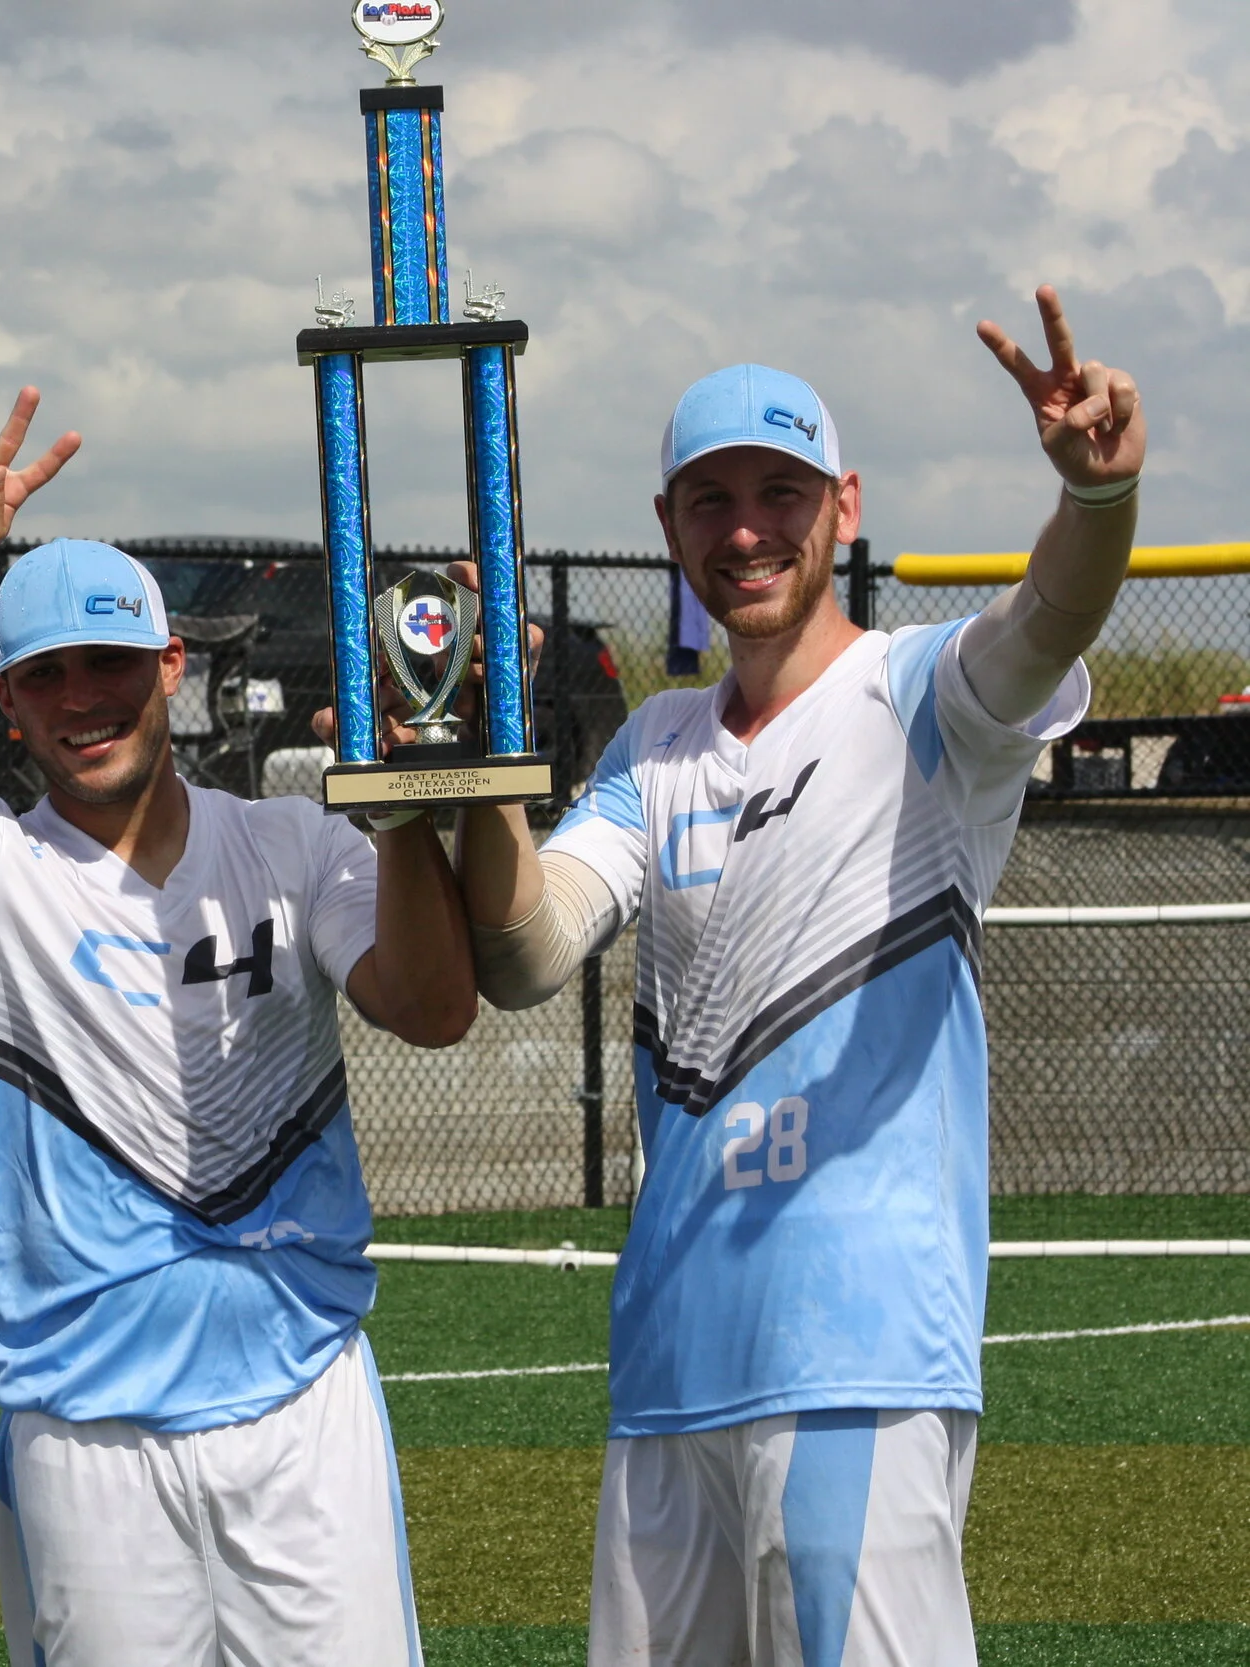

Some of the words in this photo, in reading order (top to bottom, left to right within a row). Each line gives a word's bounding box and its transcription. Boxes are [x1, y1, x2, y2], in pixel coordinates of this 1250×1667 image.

[764, 407, 817, 441] C4
[85, 594, 142, 617] C4
[388, 782, 415, 790] 2018
[418, 780, 455, 788] TEXAS
[458, 778, 491, 786] OPEN
[398, 773, 427, 781] FAST
[431, 771, 479, 779] PLASTIC
[403, 786, 477, 797] CHAMPION
[659, 758, 822, 891] C4
[69, 918, 274, 1007] C4
[723, 1095, 809, 1191] 28
